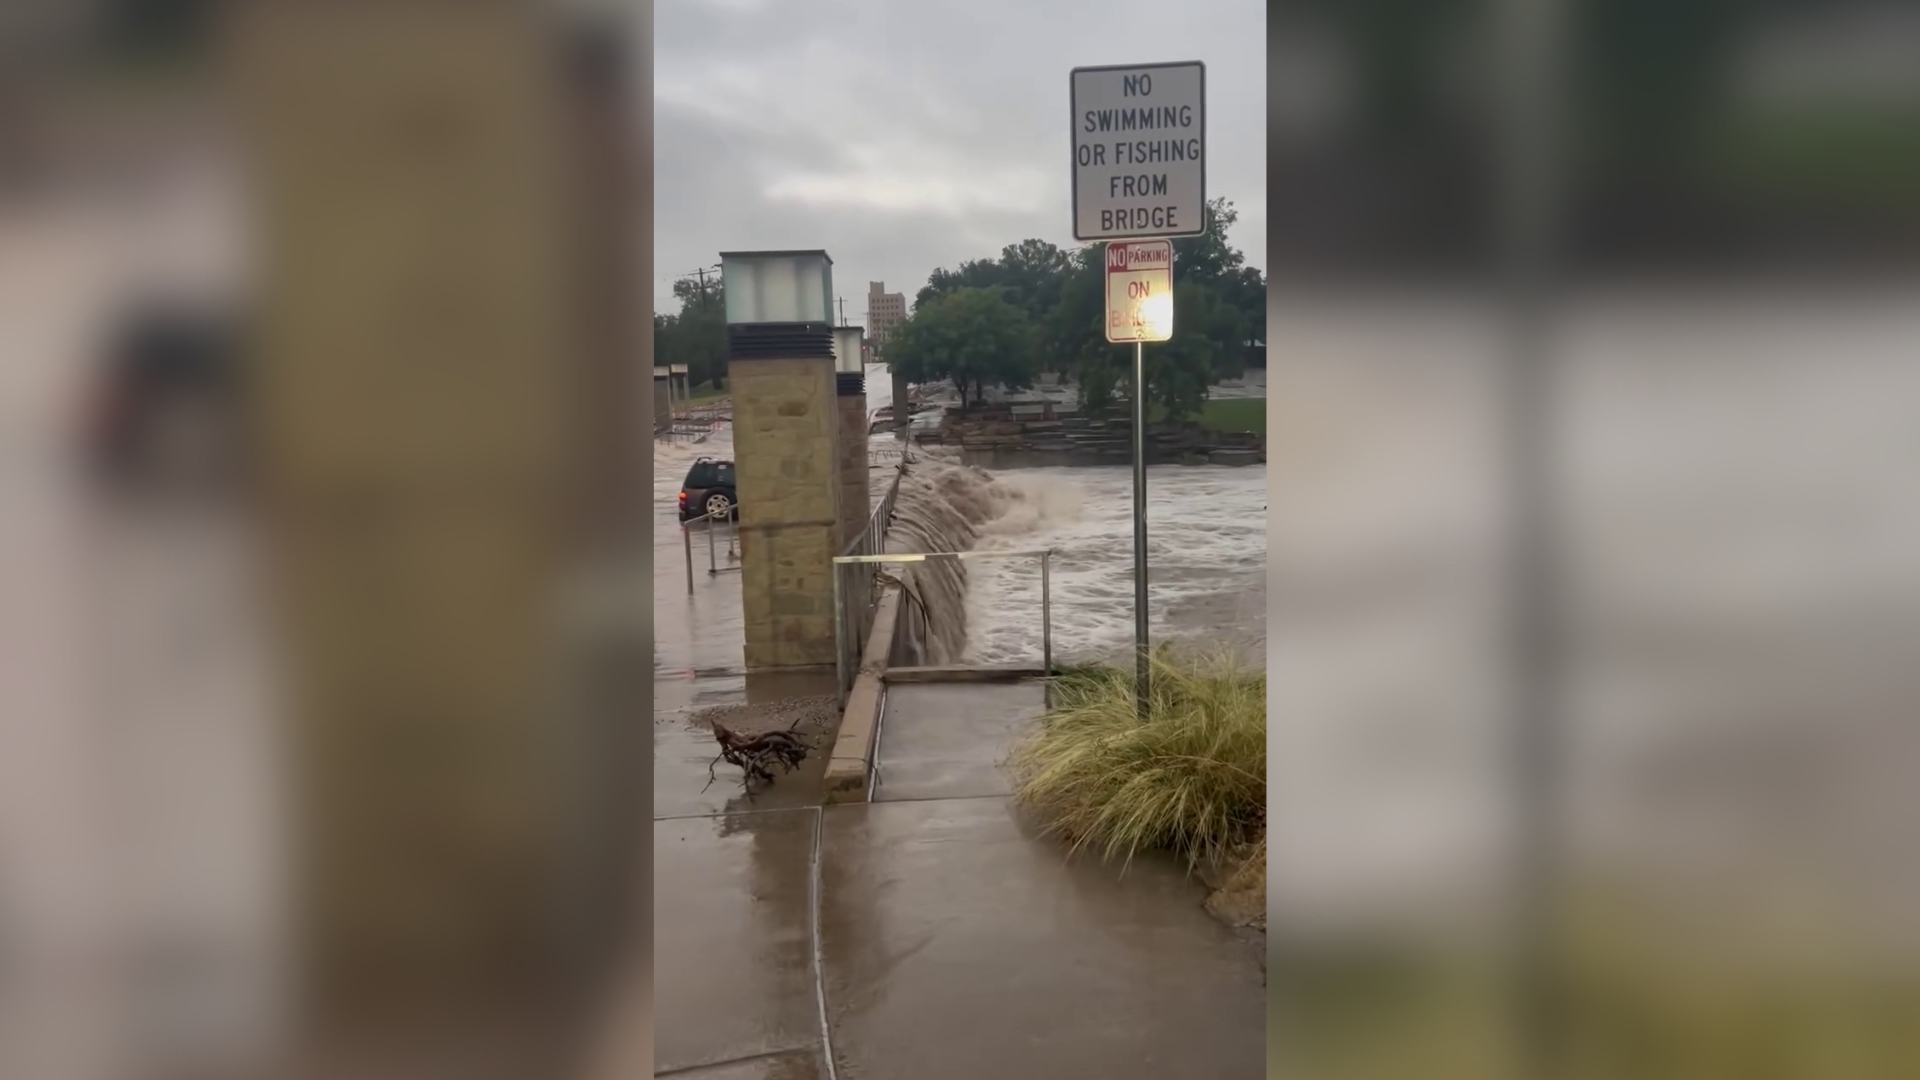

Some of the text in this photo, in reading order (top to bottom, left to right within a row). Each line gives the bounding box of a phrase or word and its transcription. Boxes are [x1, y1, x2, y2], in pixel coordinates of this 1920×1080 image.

[1123, 73, 1151, 97] NO
[1084, 105, 1192, 132] SWIMMING
[1078, 138, 1199, 166] OR FISHING
[1110, 174, 1167, 198] FROM
[1101, 206, 1178, 231] BRIDGE
[1109, 248, 1168, 267] NO PARKING
[1128, 281, 1150, 299] ON
